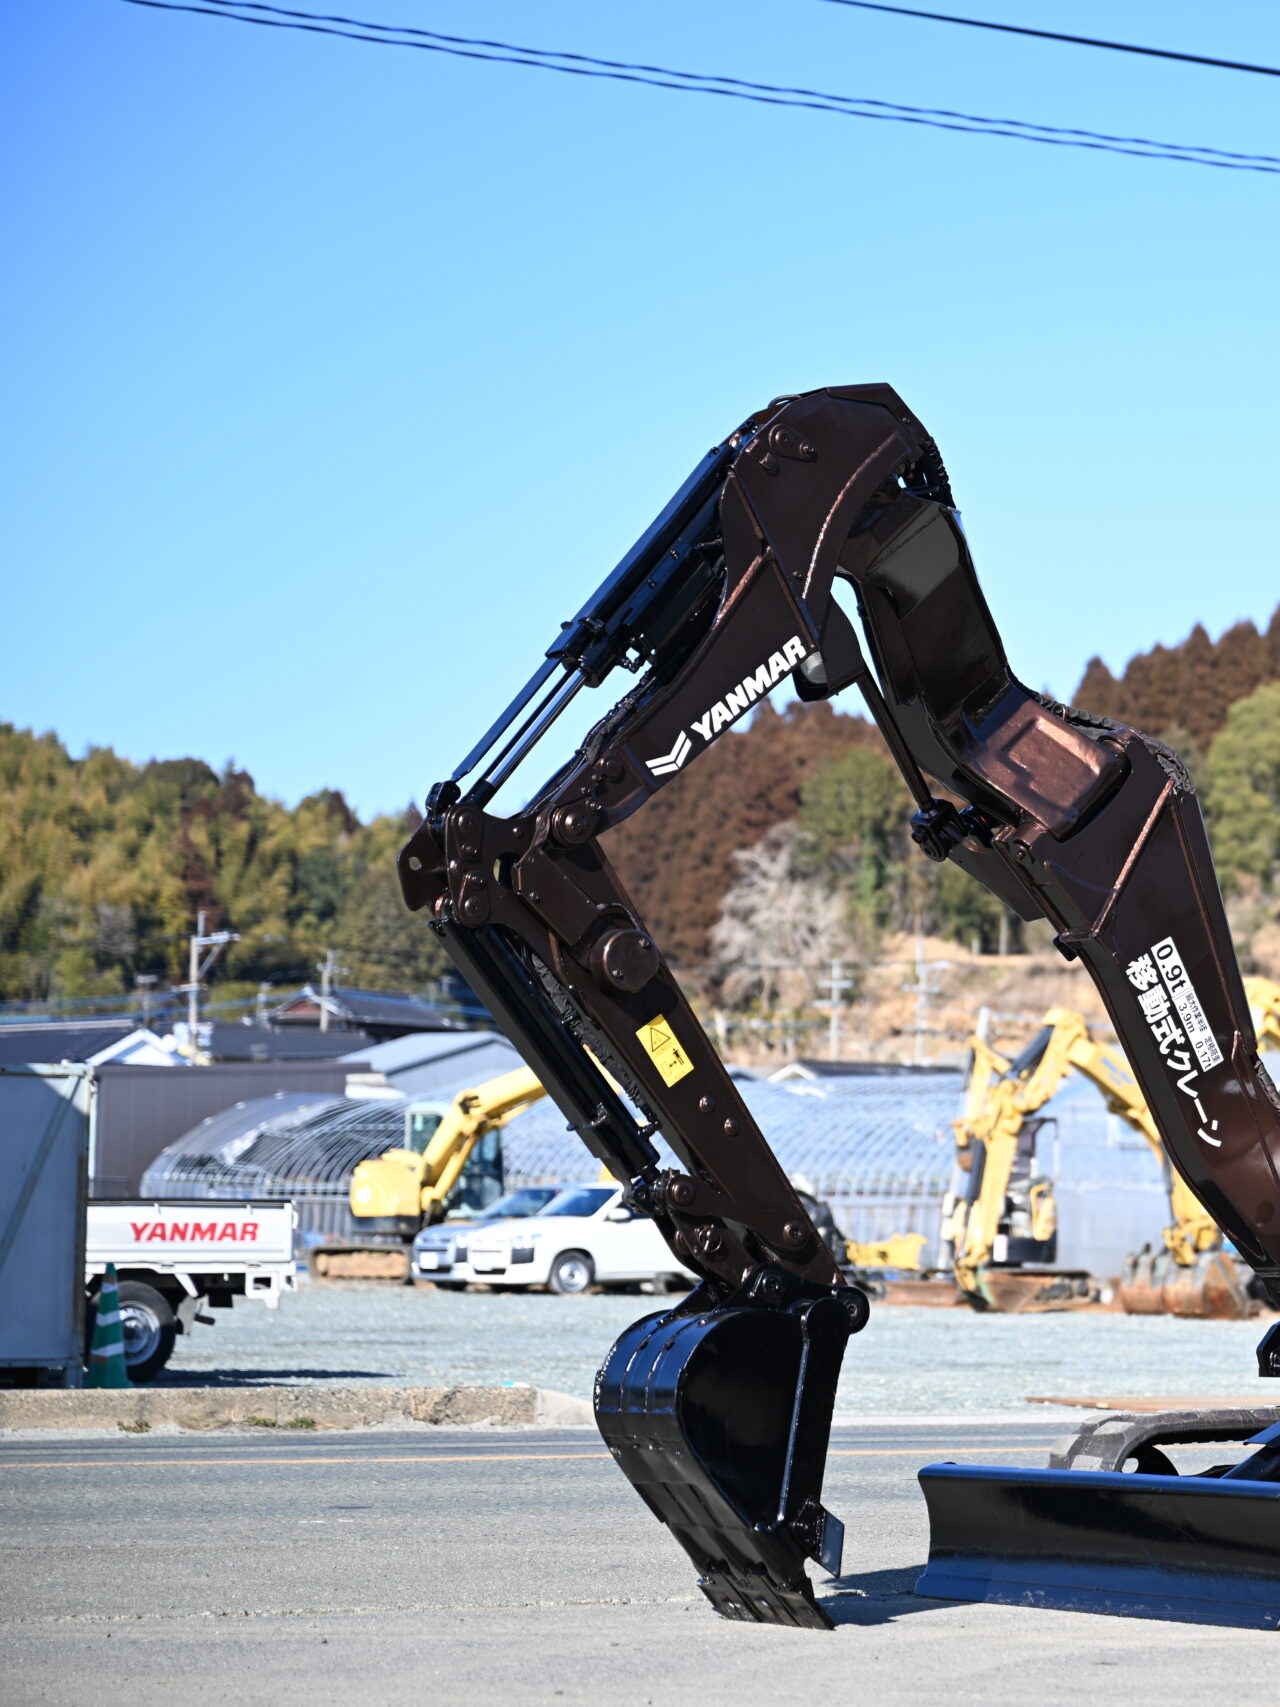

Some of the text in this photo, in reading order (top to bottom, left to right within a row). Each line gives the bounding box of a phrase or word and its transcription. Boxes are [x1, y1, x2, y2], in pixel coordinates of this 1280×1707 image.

[690, 635, 807, 742] YANMAR
[1156, 944, 1187, 993] 0.9t
[1125, 953, 1222, 1147] 移動式クレーン
[1178, 1002, 1212, 1070] 3.9m 0.17t
[129, 1222, 259, 1242] YANMAR
